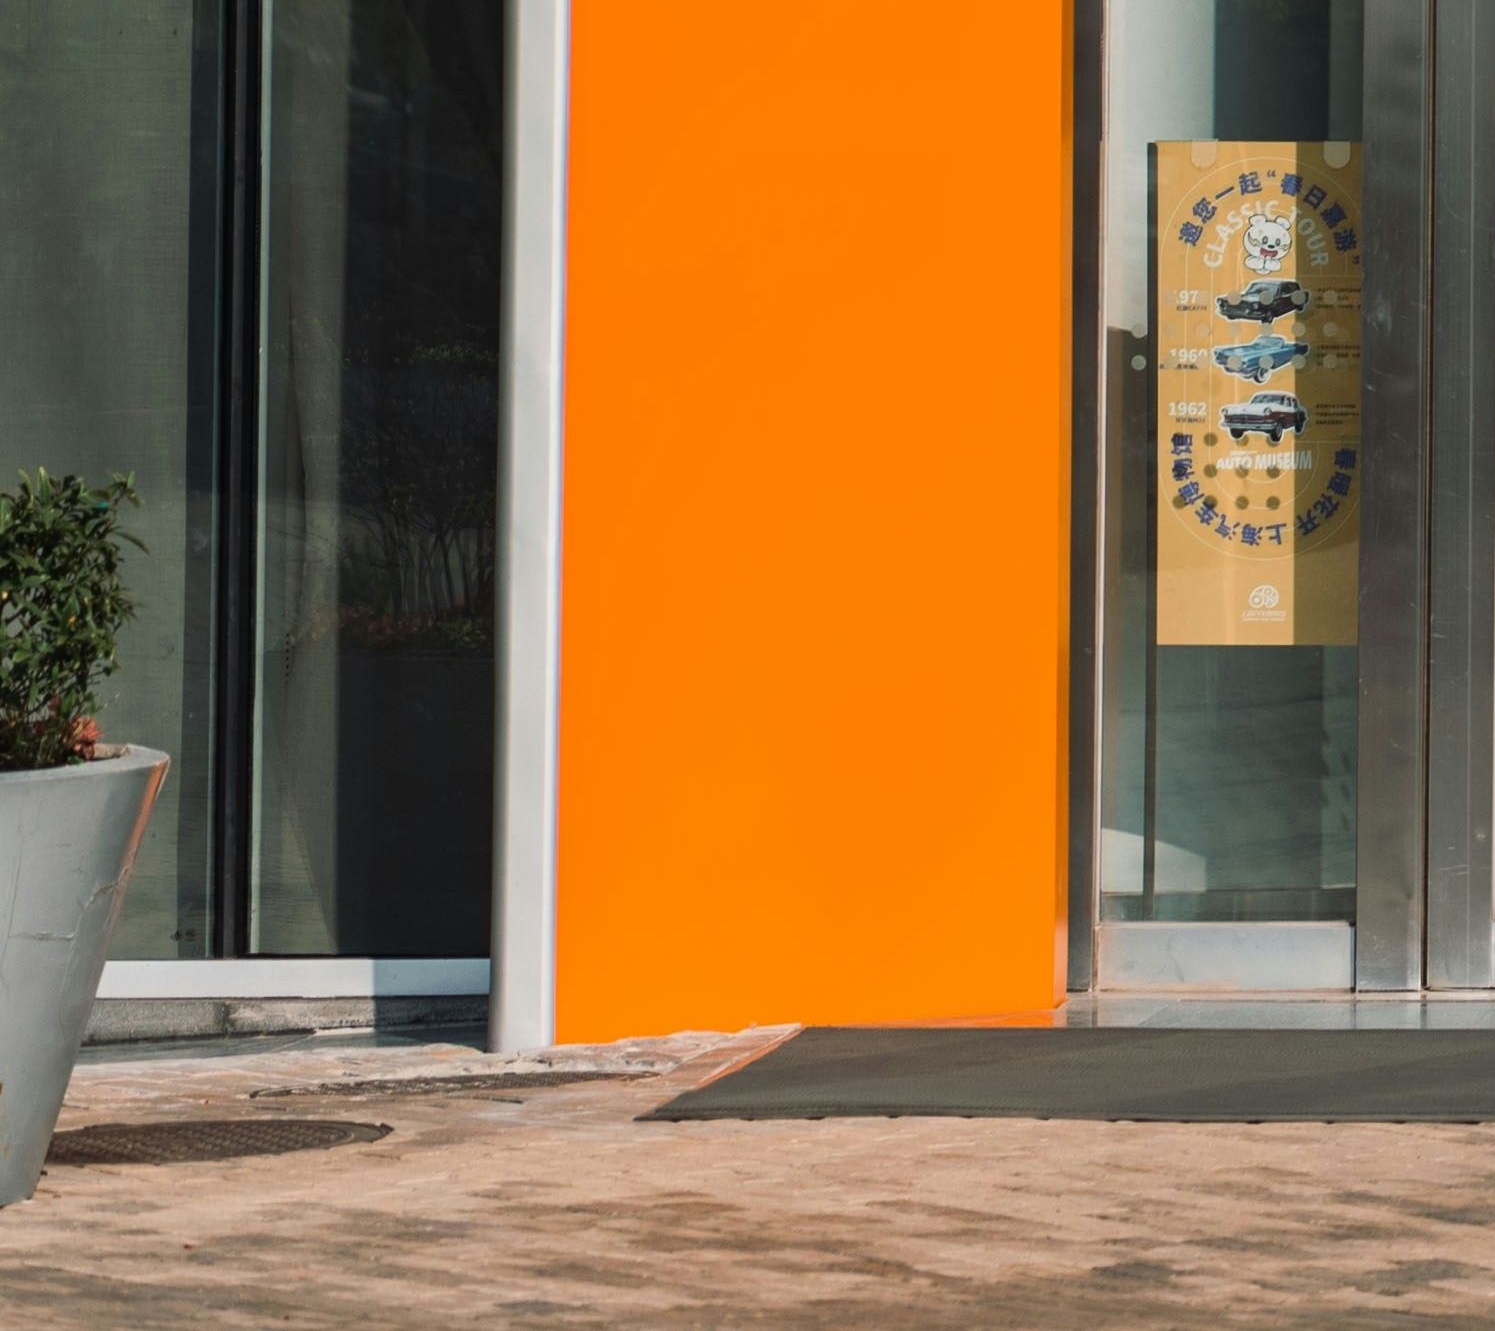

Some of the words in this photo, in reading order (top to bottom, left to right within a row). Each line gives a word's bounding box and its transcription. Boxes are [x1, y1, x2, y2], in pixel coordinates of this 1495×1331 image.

[1203, 200, 1280, 268] CLASSIC
[1289, 205, 1330, 267] TOUR
[1168, 290, 1208, 305] 97
[1168, 401, 1208, 417] 1962
[1216, 455, 1252, 470] AUTO
[1255, 449, 1312, 470] MUSEUM
[1170, 433, 1287, 546] 上海汽车博物馆
